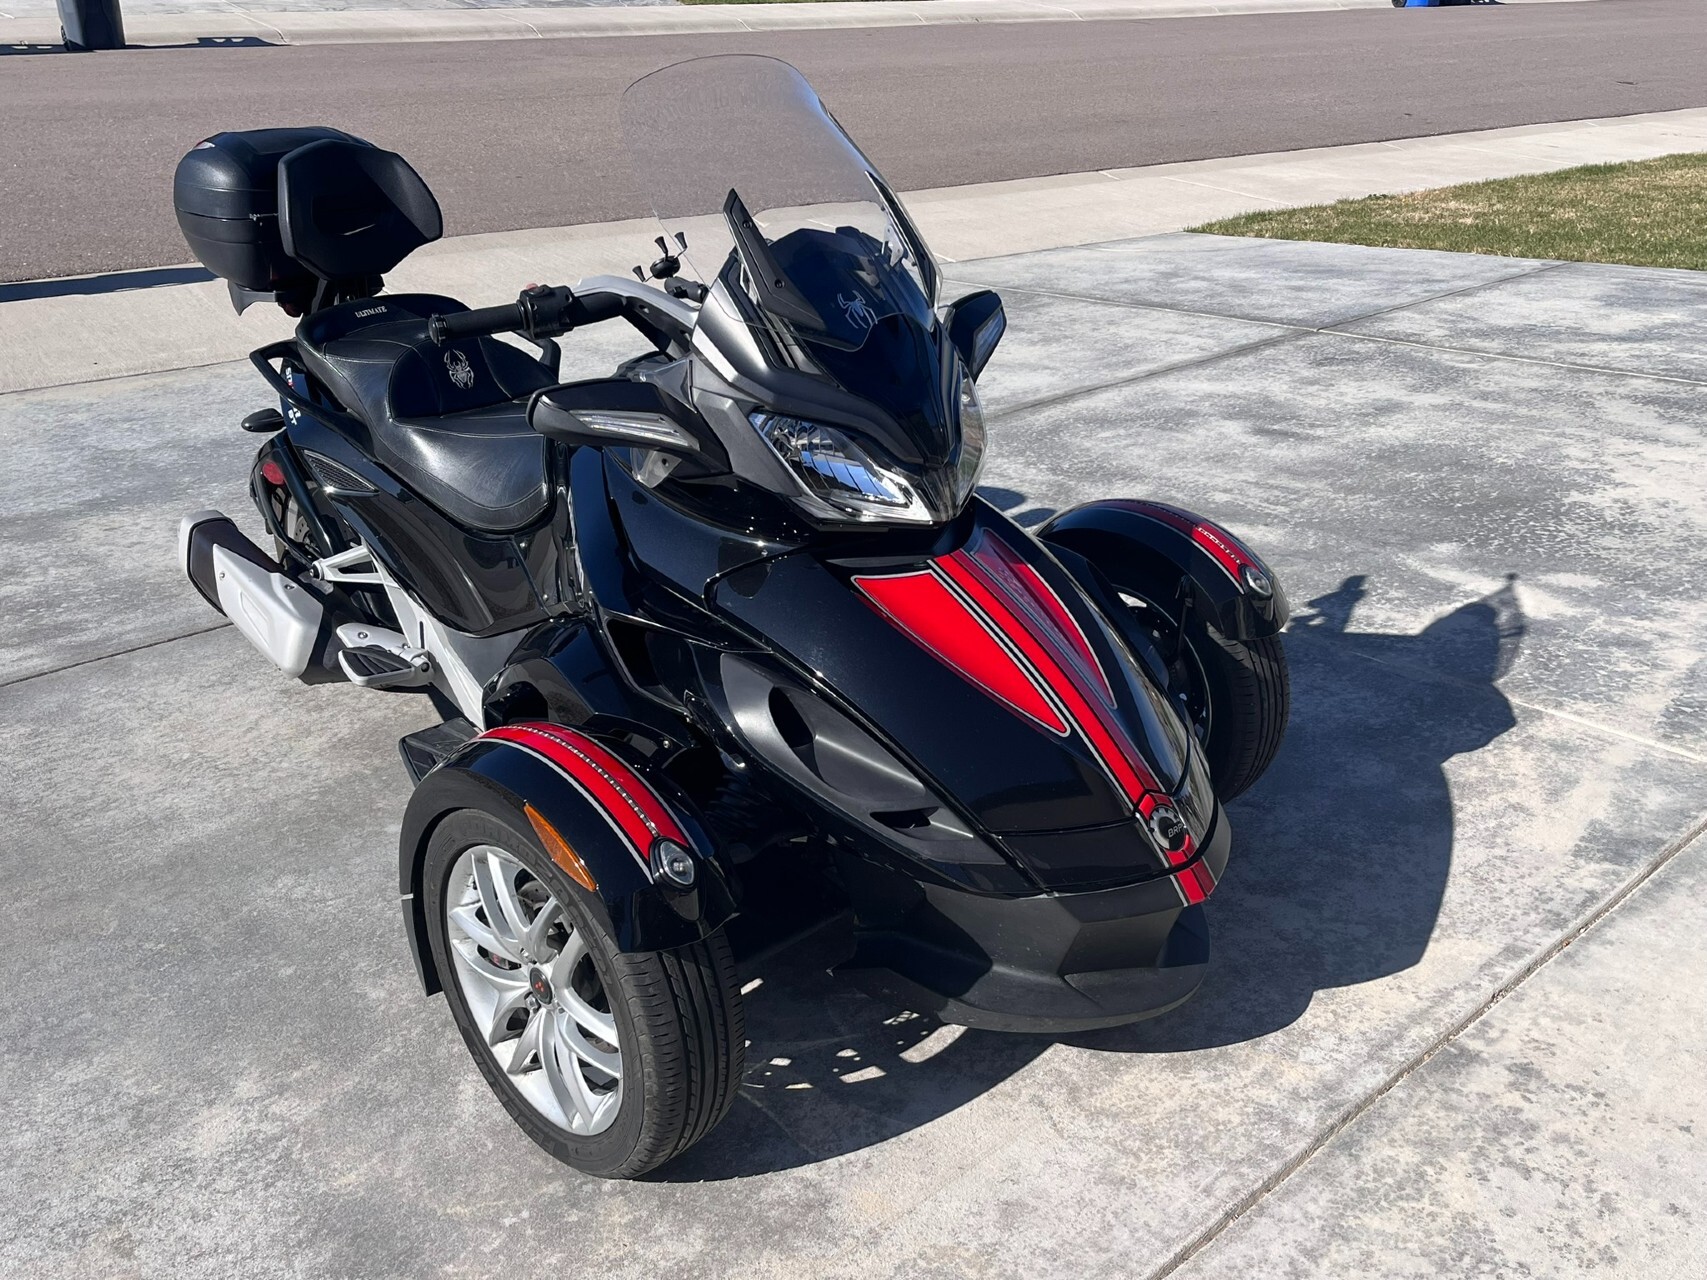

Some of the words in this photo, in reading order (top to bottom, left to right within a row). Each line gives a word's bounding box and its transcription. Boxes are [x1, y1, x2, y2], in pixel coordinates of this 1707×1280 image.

[355, 305, 387, 318] ULTIMATE
[1167, 823, 1184, 838] BRP
[472, 1045, 556, 1154] FEDERAL
